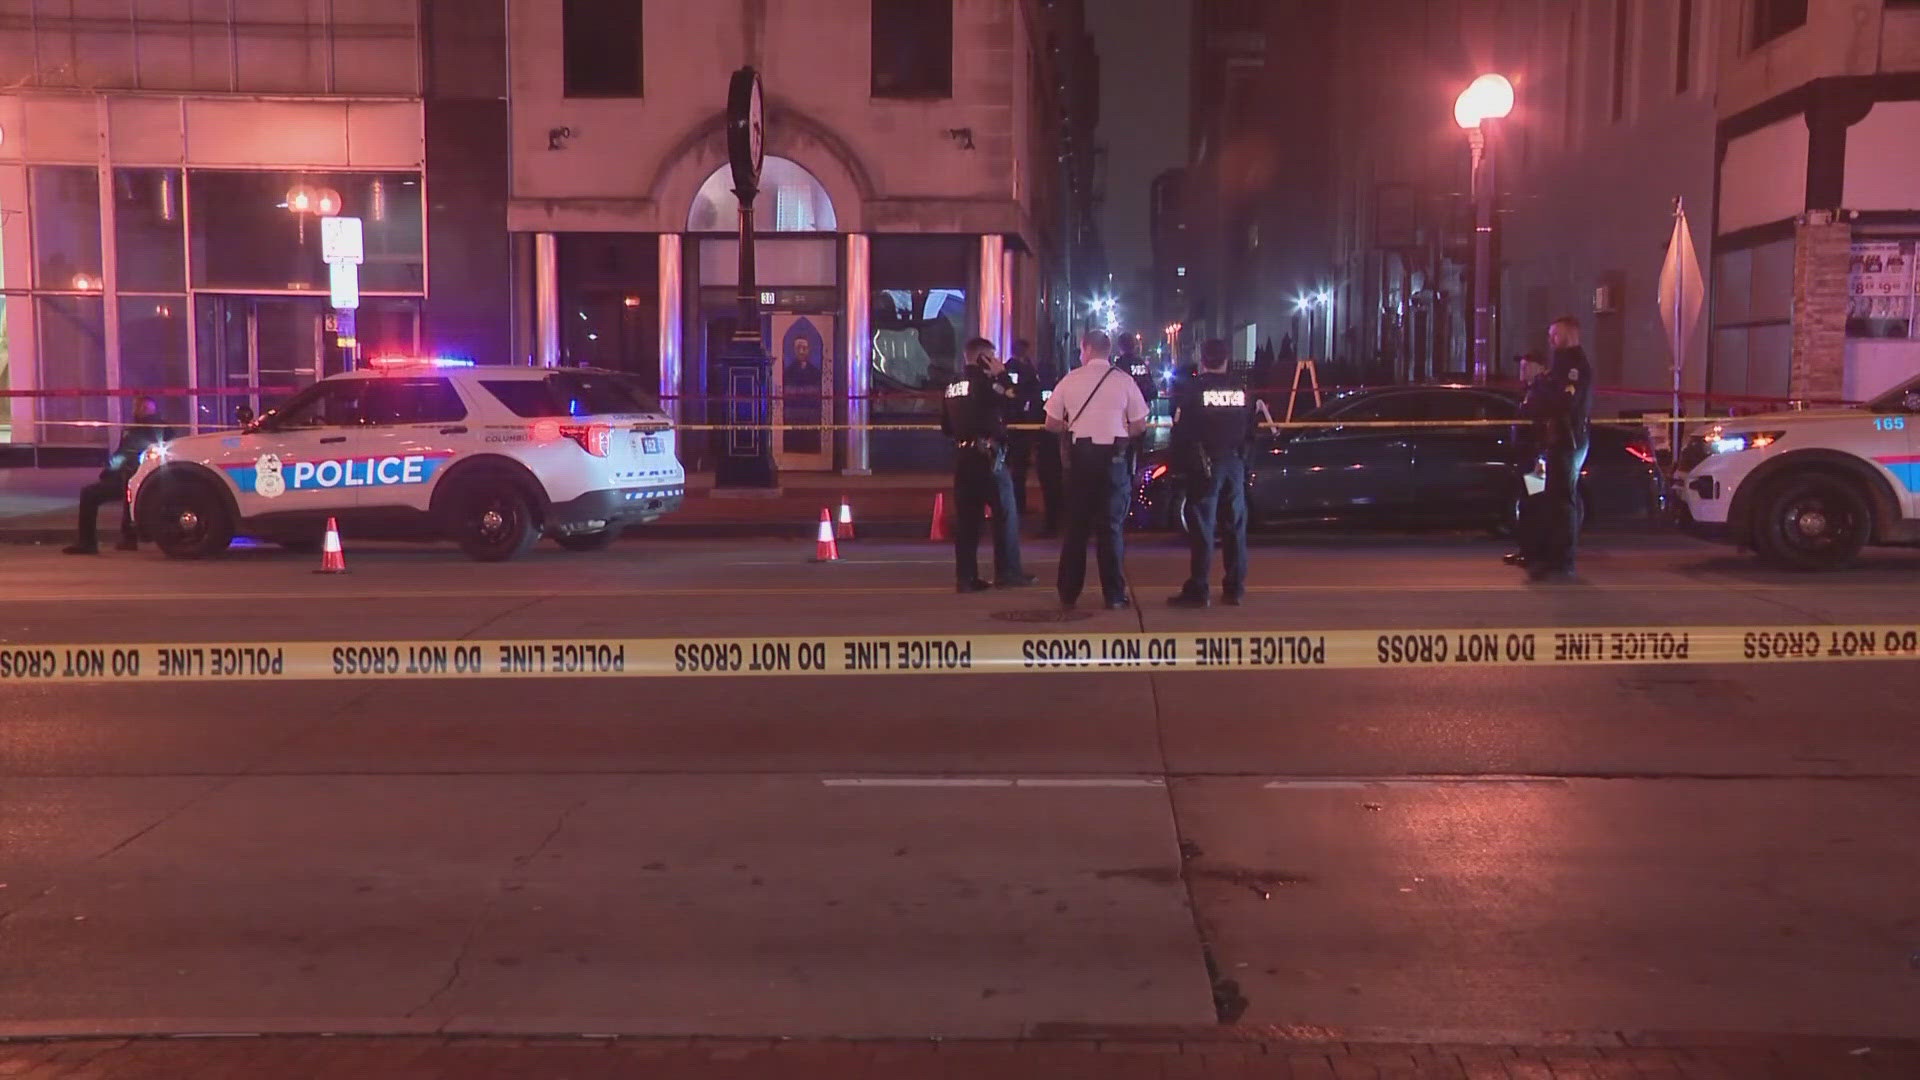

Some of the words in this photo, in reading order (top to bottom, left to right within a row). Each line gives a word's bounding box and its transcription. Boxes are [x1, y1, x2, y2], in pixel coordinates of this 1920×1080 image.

[762, 294, 774, 303] 30
[1873, 417, 1905, 430] 165
[294, 456, 425, 488] POLICE
[749, 643, 790, 670] NOT
[798, 642, 825, 670] DO
[844, 641, 890, 669] LINE
[898, 640, 971, 669] POLICE
[1022, 639, 1092, 668] CROSS
[1098, 639, 1140, 667] NOT
[1148, 638, 1176, 666] DO
[1195, 637, 1242, 666] LINE
[1250, 636, 1325, 665] POLICE
[1378, 634, 1447, 663] CROSS
[1455, 634, 1498, 662] NOT
[1506, 633, 1535, 662] DO
[1555, 633, 1603, 661] LINE
[1610, 632, 1689, 660] POLICE
[1744, 631, 1820, 659] CROSS
[1828, 631, 1875, 657] NOT
[1885, 630, 1917, 656] DO
[0, 650, 56, 678] CROS
[62, 649, 104, 677] NOT
[112, 649, 139, 677] DO
[158, 648, 203, 676] LINE
[211, 648, 283, 675] POLICE
[332, 646, 399, 674] CROSS
[406, 646, 446, 673] NOT
[454, 646, 481, 673] DO
[500, 645, 545, 672] LINE
[552, 645, 625, 672] POLICE
[675, 643, 742, 672] CROSS
